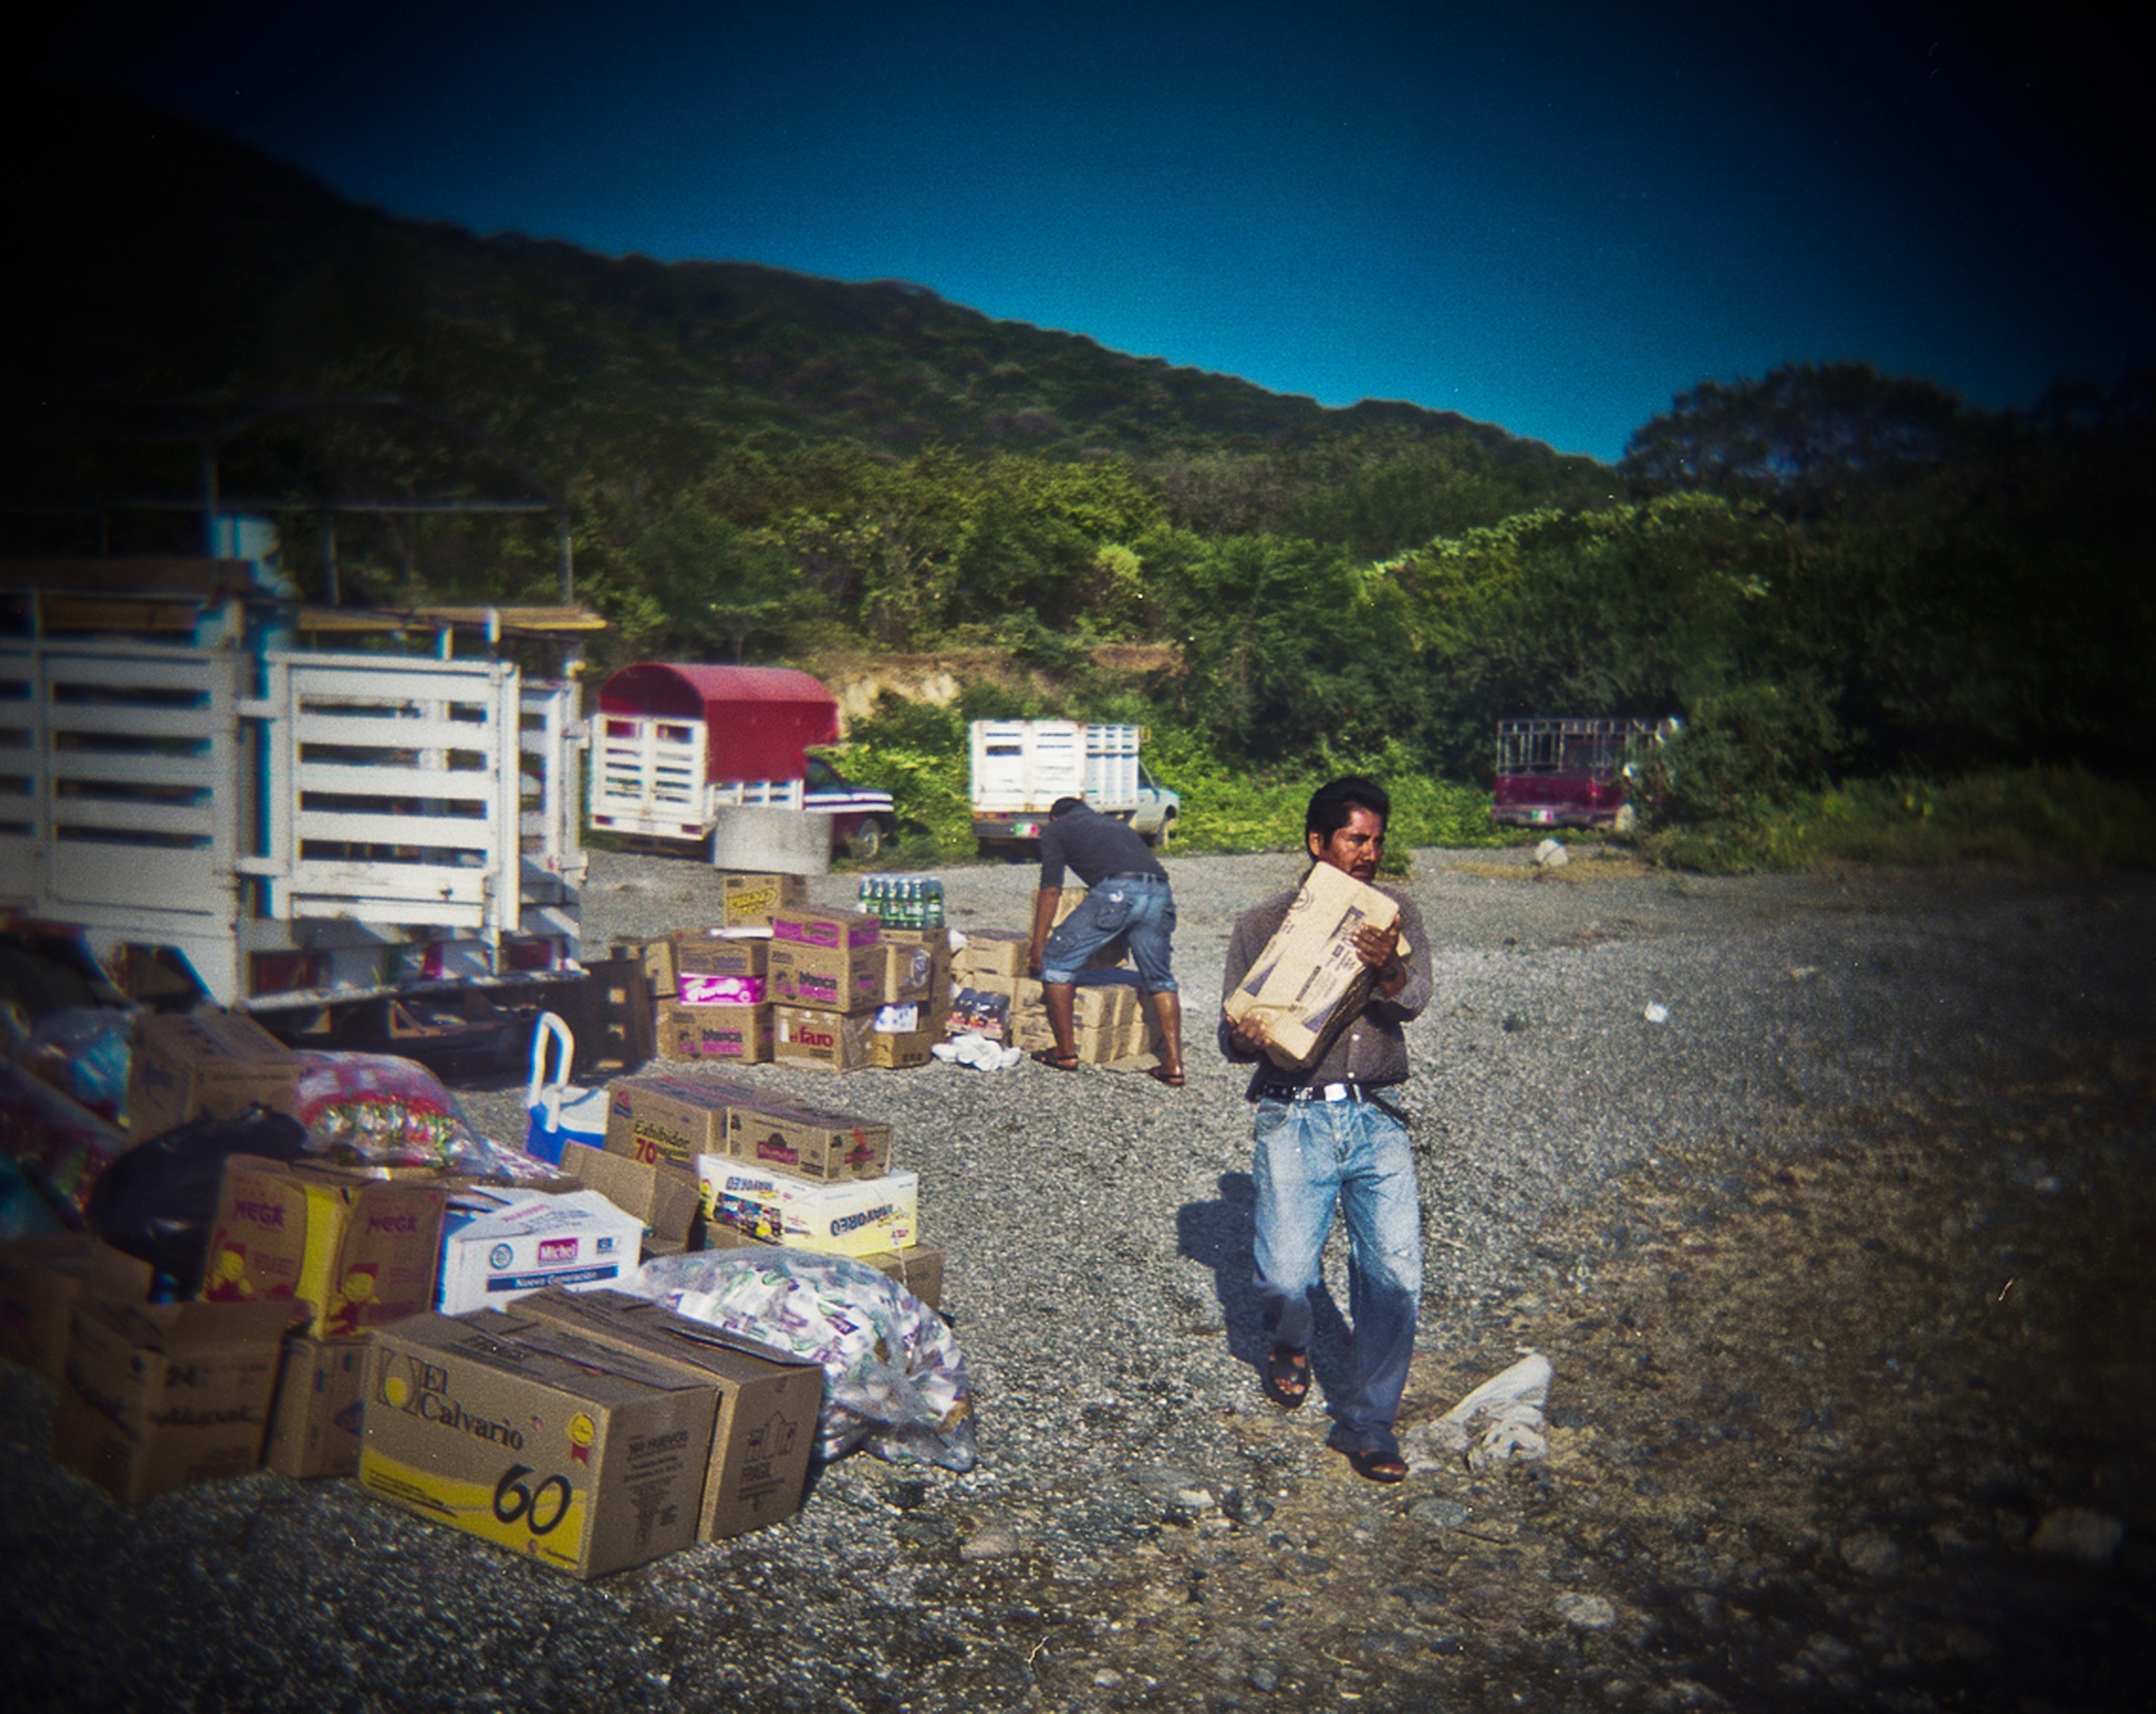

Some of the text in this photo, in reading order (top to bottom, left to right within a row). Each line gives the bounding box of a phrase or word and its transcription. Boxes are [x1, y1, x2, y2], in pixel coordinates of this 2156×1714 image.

[799, 1026, 834, 1047] faro
[634, 1120, 691, 1150] Exhibidor
[634, 1137, 658, 1164] 70
[725, 1176, 775, 1192] MAYOREO
[830, 1203, 894, 1237] MAYOREO
[540, 1242, 577, 1260] Michel
[423, 1364, 449, 1395] El
[421, 1393, 525, 1451] Calvario
[493, 1463, 573, 1536] 60
